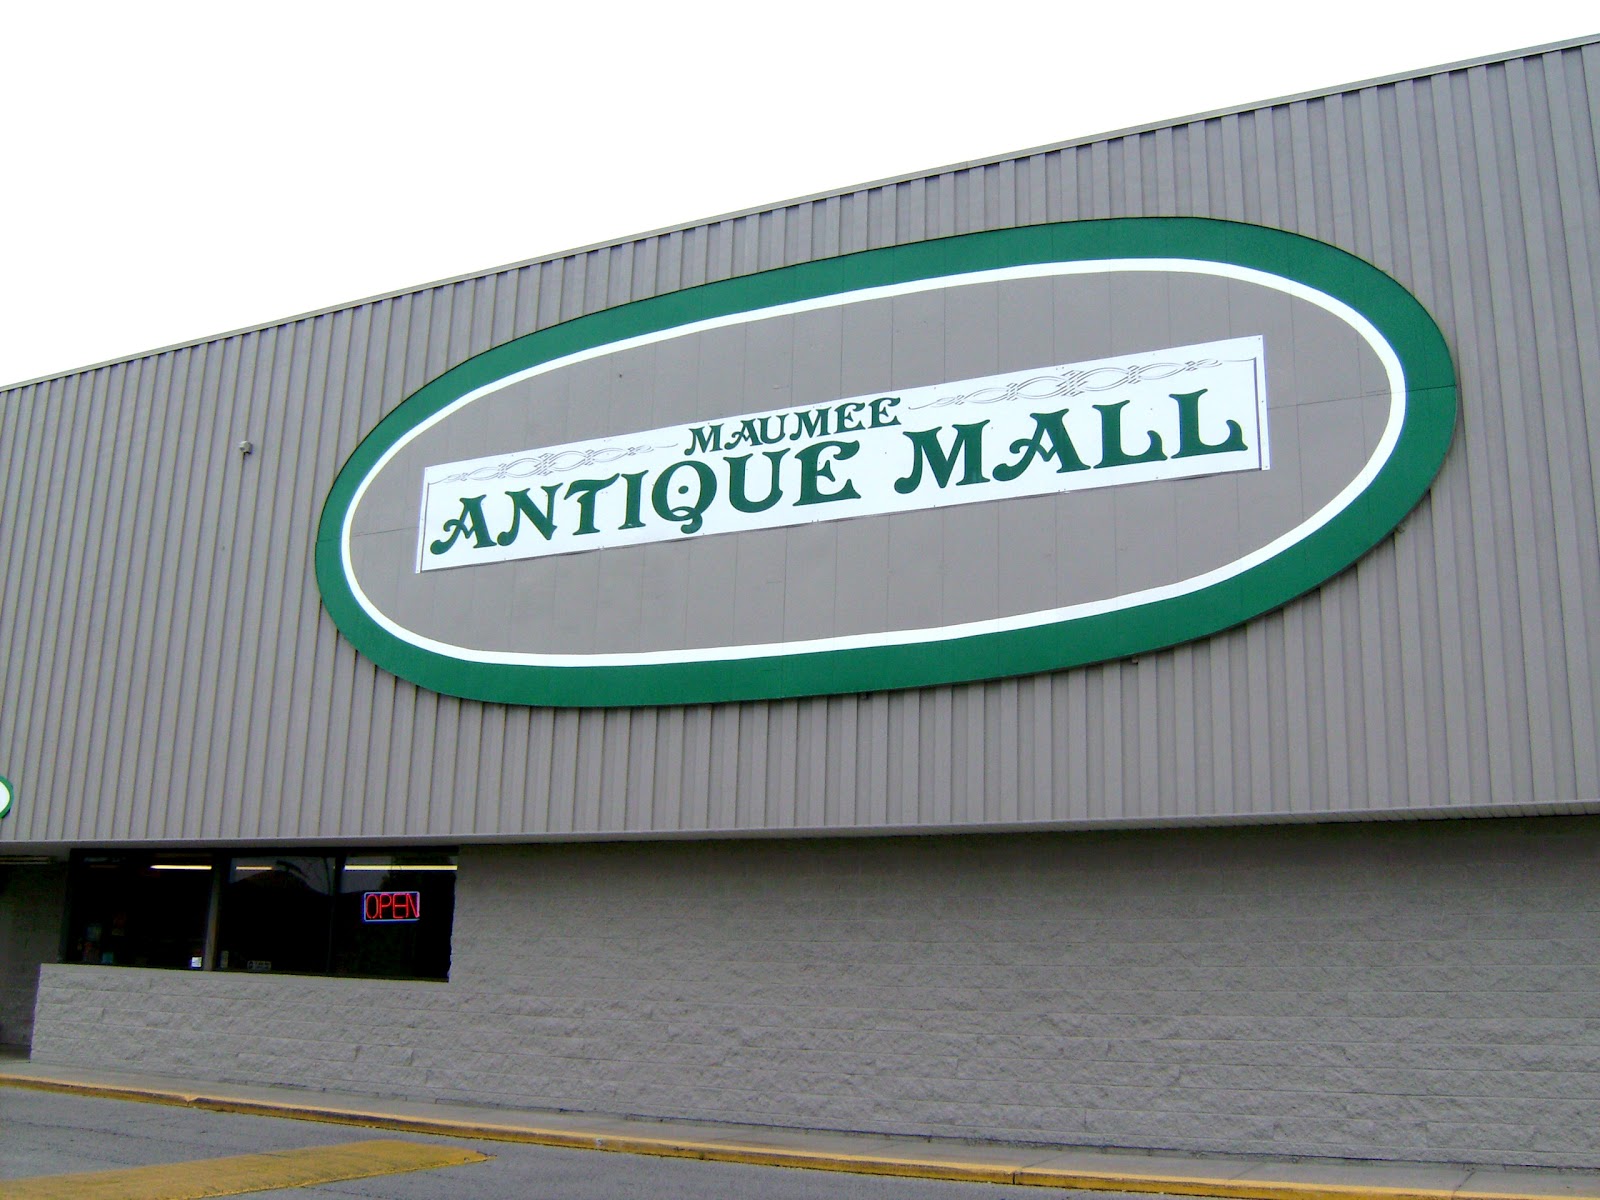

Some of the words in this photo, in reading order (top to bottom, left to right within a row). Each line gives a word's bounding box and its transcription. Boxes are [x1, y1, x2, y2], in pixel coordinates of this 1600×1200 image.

[685, 397, 901, 456] MAUMEE
[430, 441, 861, 555] ANTIQUE
[895, 388, 1248, 495] MALL
[365, 893, 420, 919] OPEN
